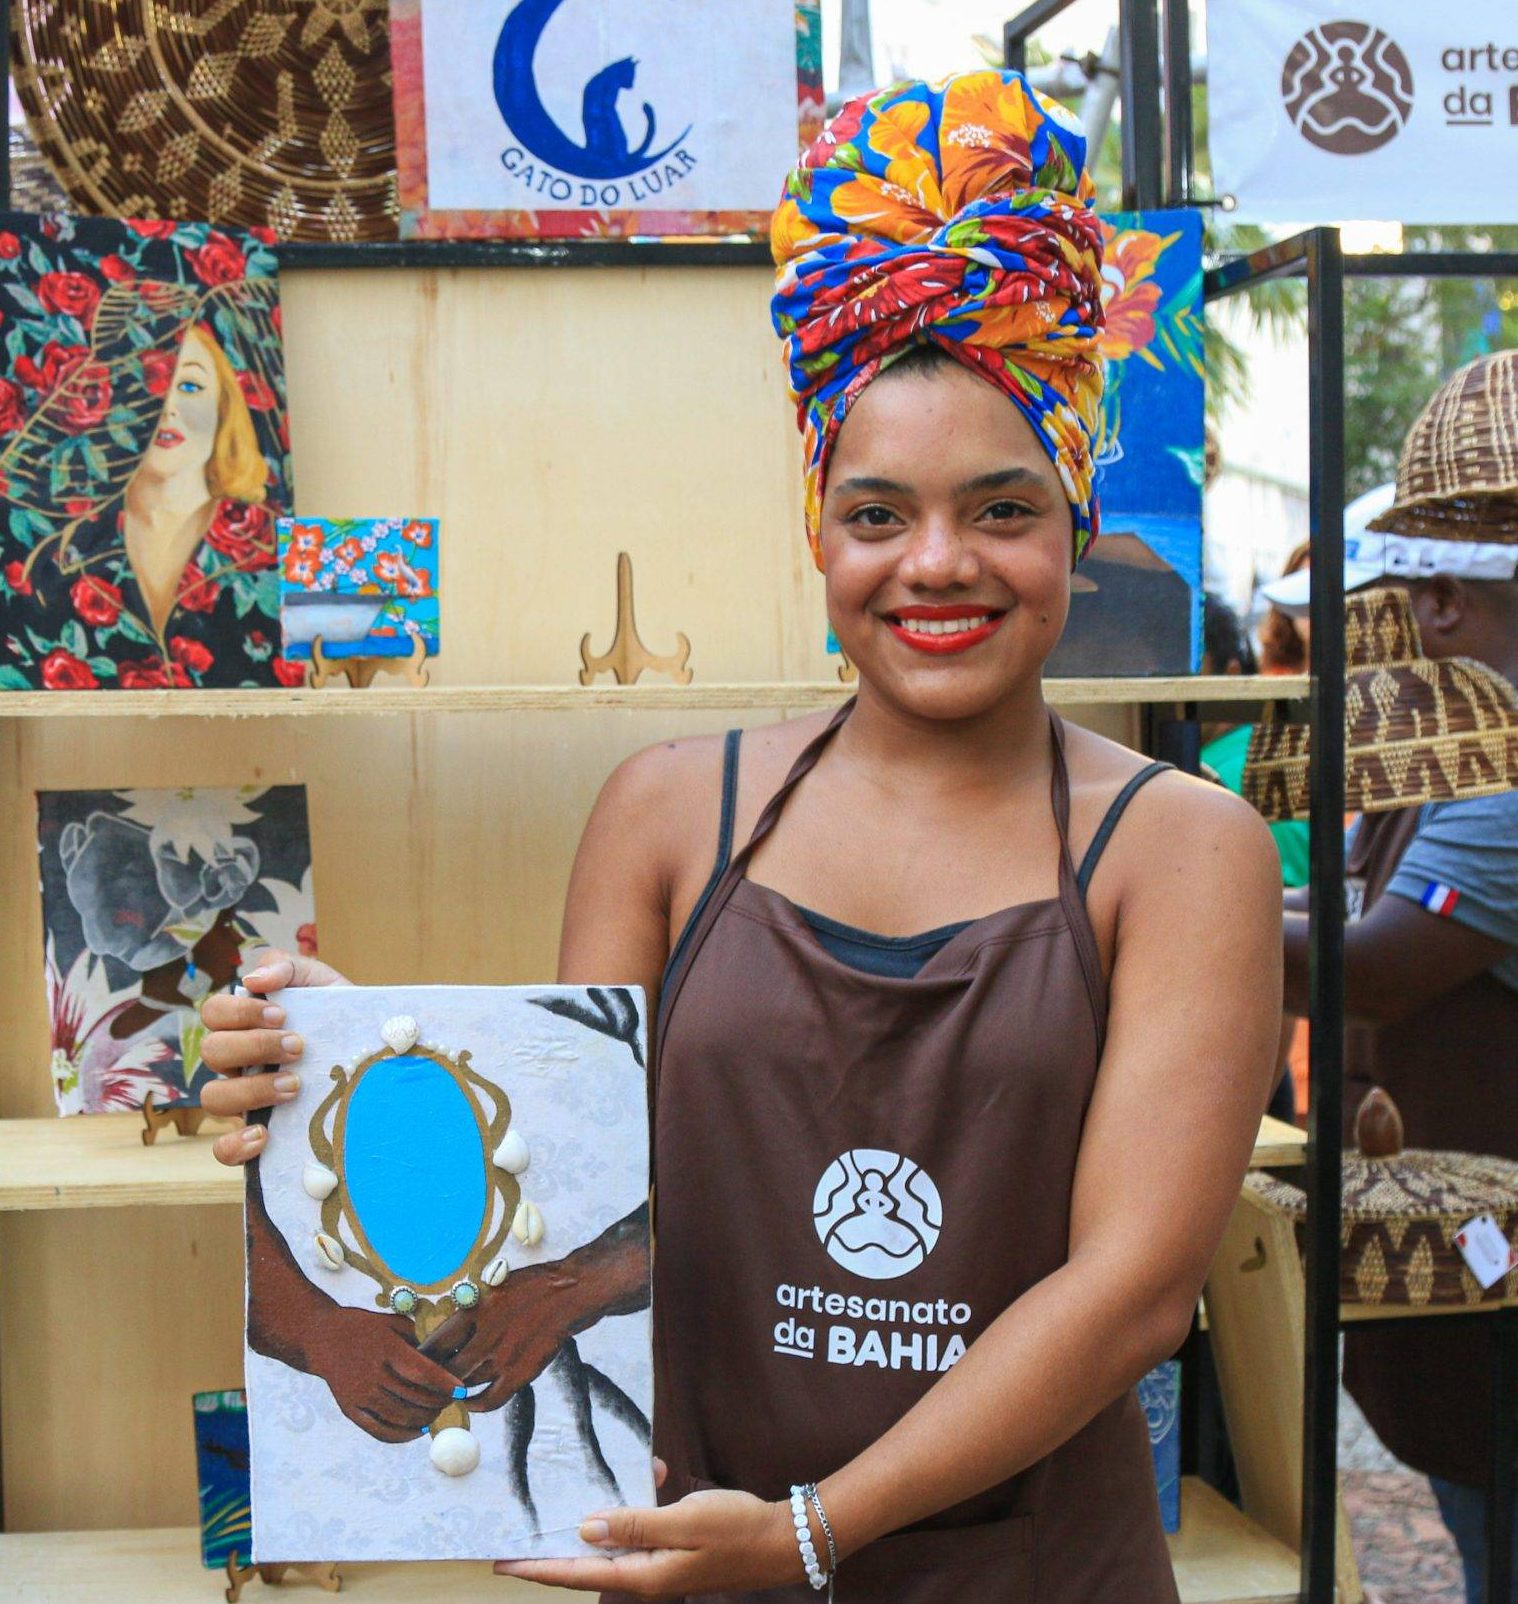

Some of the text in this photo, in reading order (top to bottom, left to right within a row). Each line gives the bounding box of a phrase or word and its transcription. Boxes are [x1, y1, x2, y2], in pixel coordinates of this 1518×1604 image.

[1444, 86, 1492, 116] da
[501, 147, 697, 206] GATO DO LUAR
[776, 1283, 972, 1325] artesanato
[773, 1318, 967, 1372] da BAHIA
